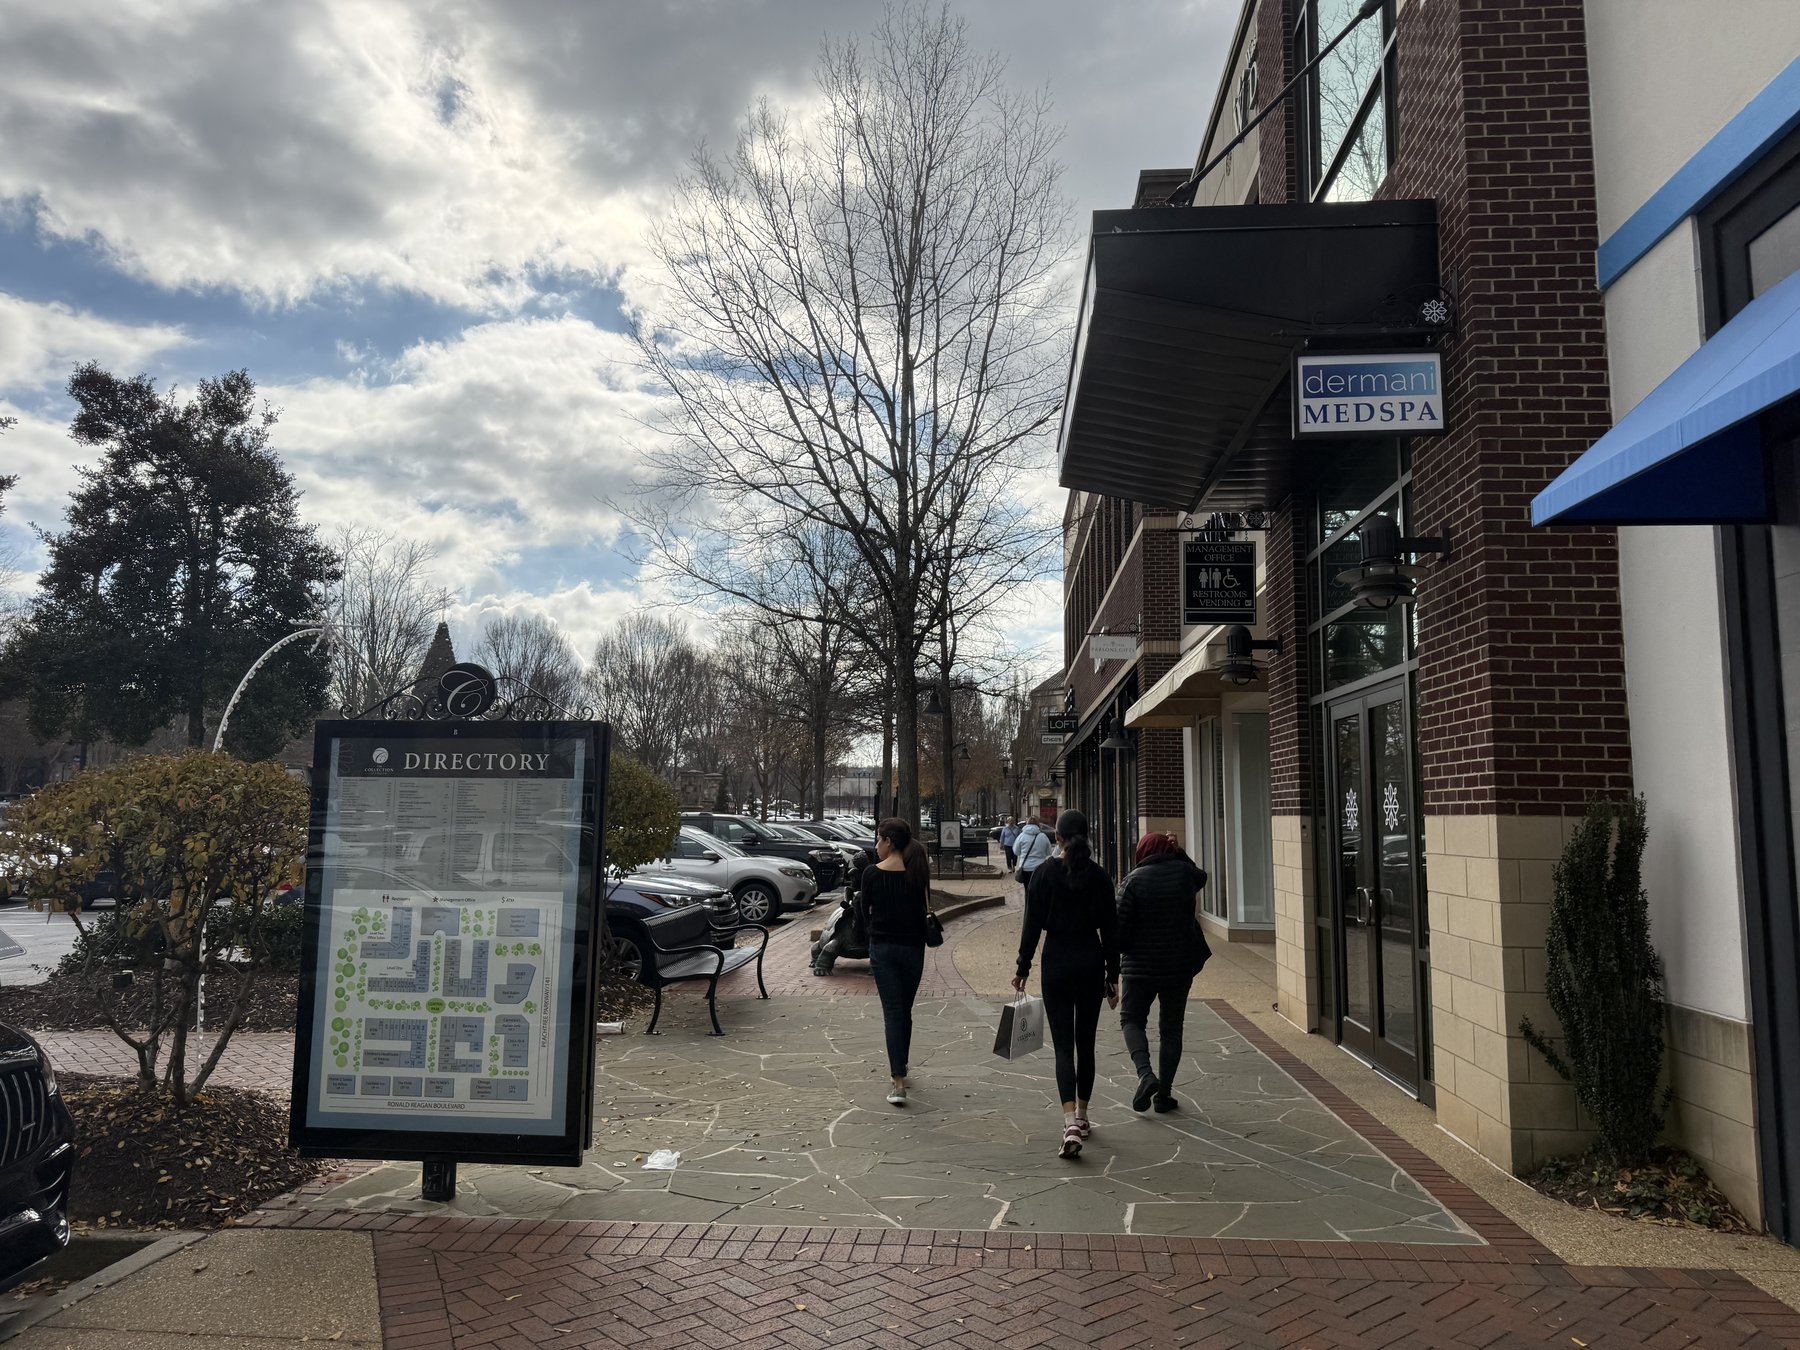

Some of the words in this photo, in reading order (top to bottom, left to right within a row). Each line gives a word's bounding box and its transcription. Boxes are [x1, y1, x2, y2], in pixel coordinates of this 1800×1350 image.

[1305, 365, 1435, 395] dermani
[1303, 401, 1439, 425] MEDSPA
[1186, 545, 1252, 553] MANAGEMENT
[1204, 554, 1235, 562] OFFICE
[1192, 590, 1248, 598] RESTROOMS
[1199, 599, 1241, 607] VENDING
[1049, 720, 1077, 729] LOFT
[404, 752, 551, 771] DIRECTORY
